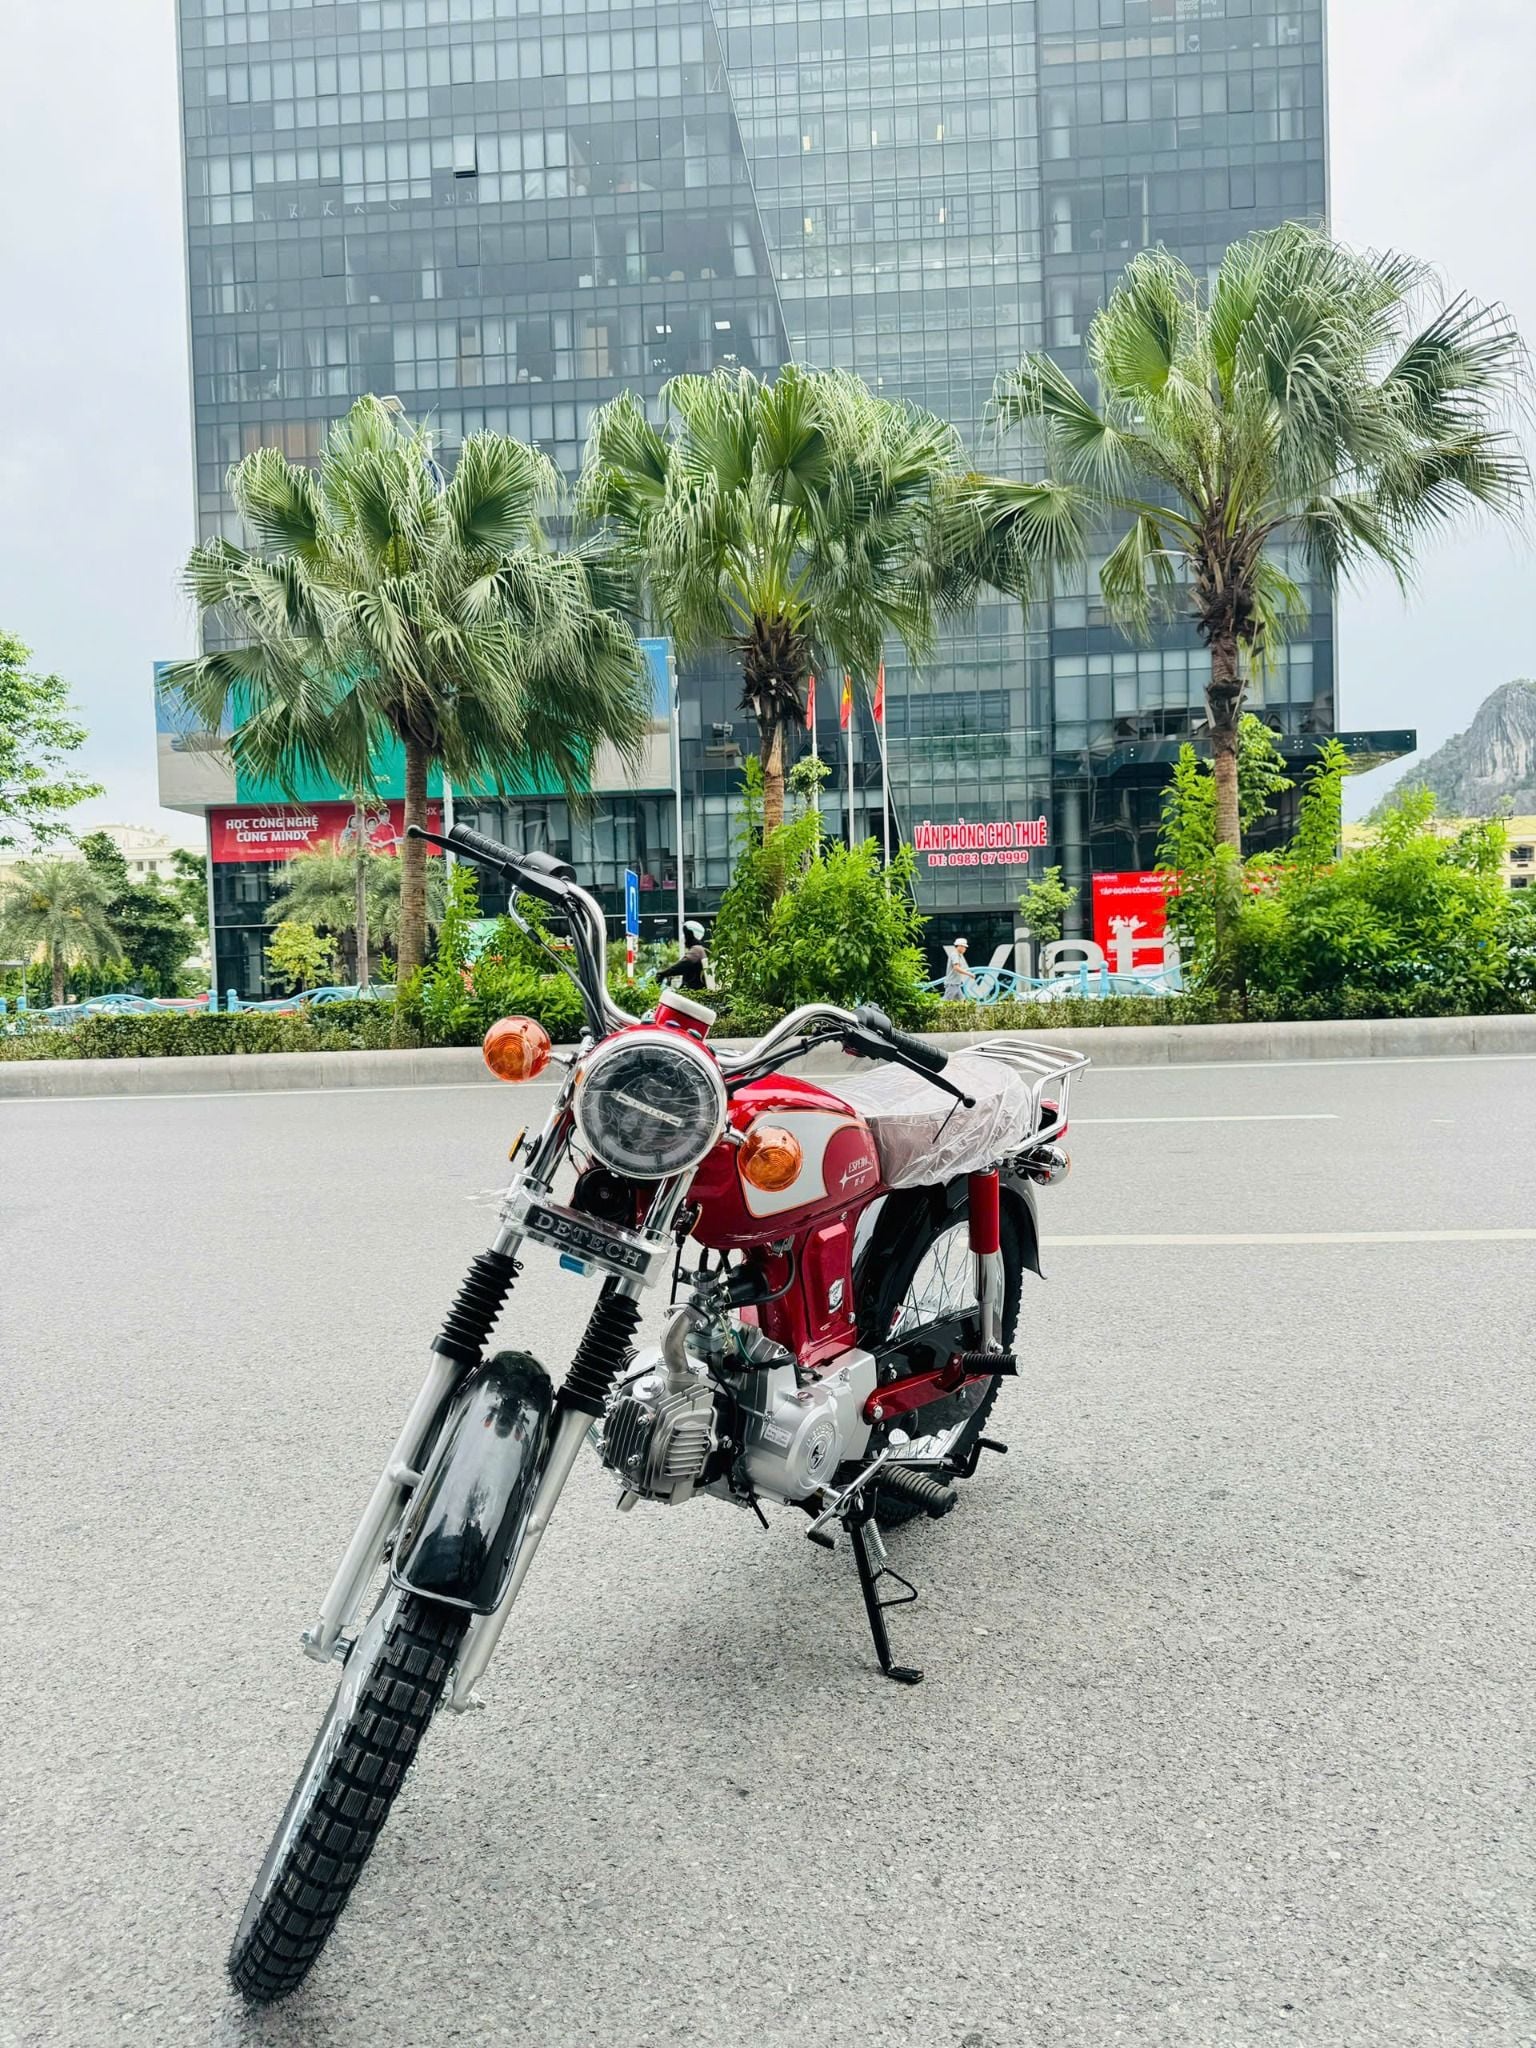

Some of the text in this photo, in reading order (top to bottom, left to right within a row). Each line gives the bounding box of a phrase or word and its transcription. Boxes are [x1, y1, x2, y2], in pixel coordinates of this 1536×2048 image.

[226, 814, 319, 832] HỌC CÔNG NGHỆ
[236, 830, 309, 842] CÙNG MINDX
[914, 815, 1048, 850] VĂN PHÒNG CHO THUÊ
[928, 850, 1029, 867] ĐT: 0983 97 9999
[534, 1211, 642, 1268] DETECH
